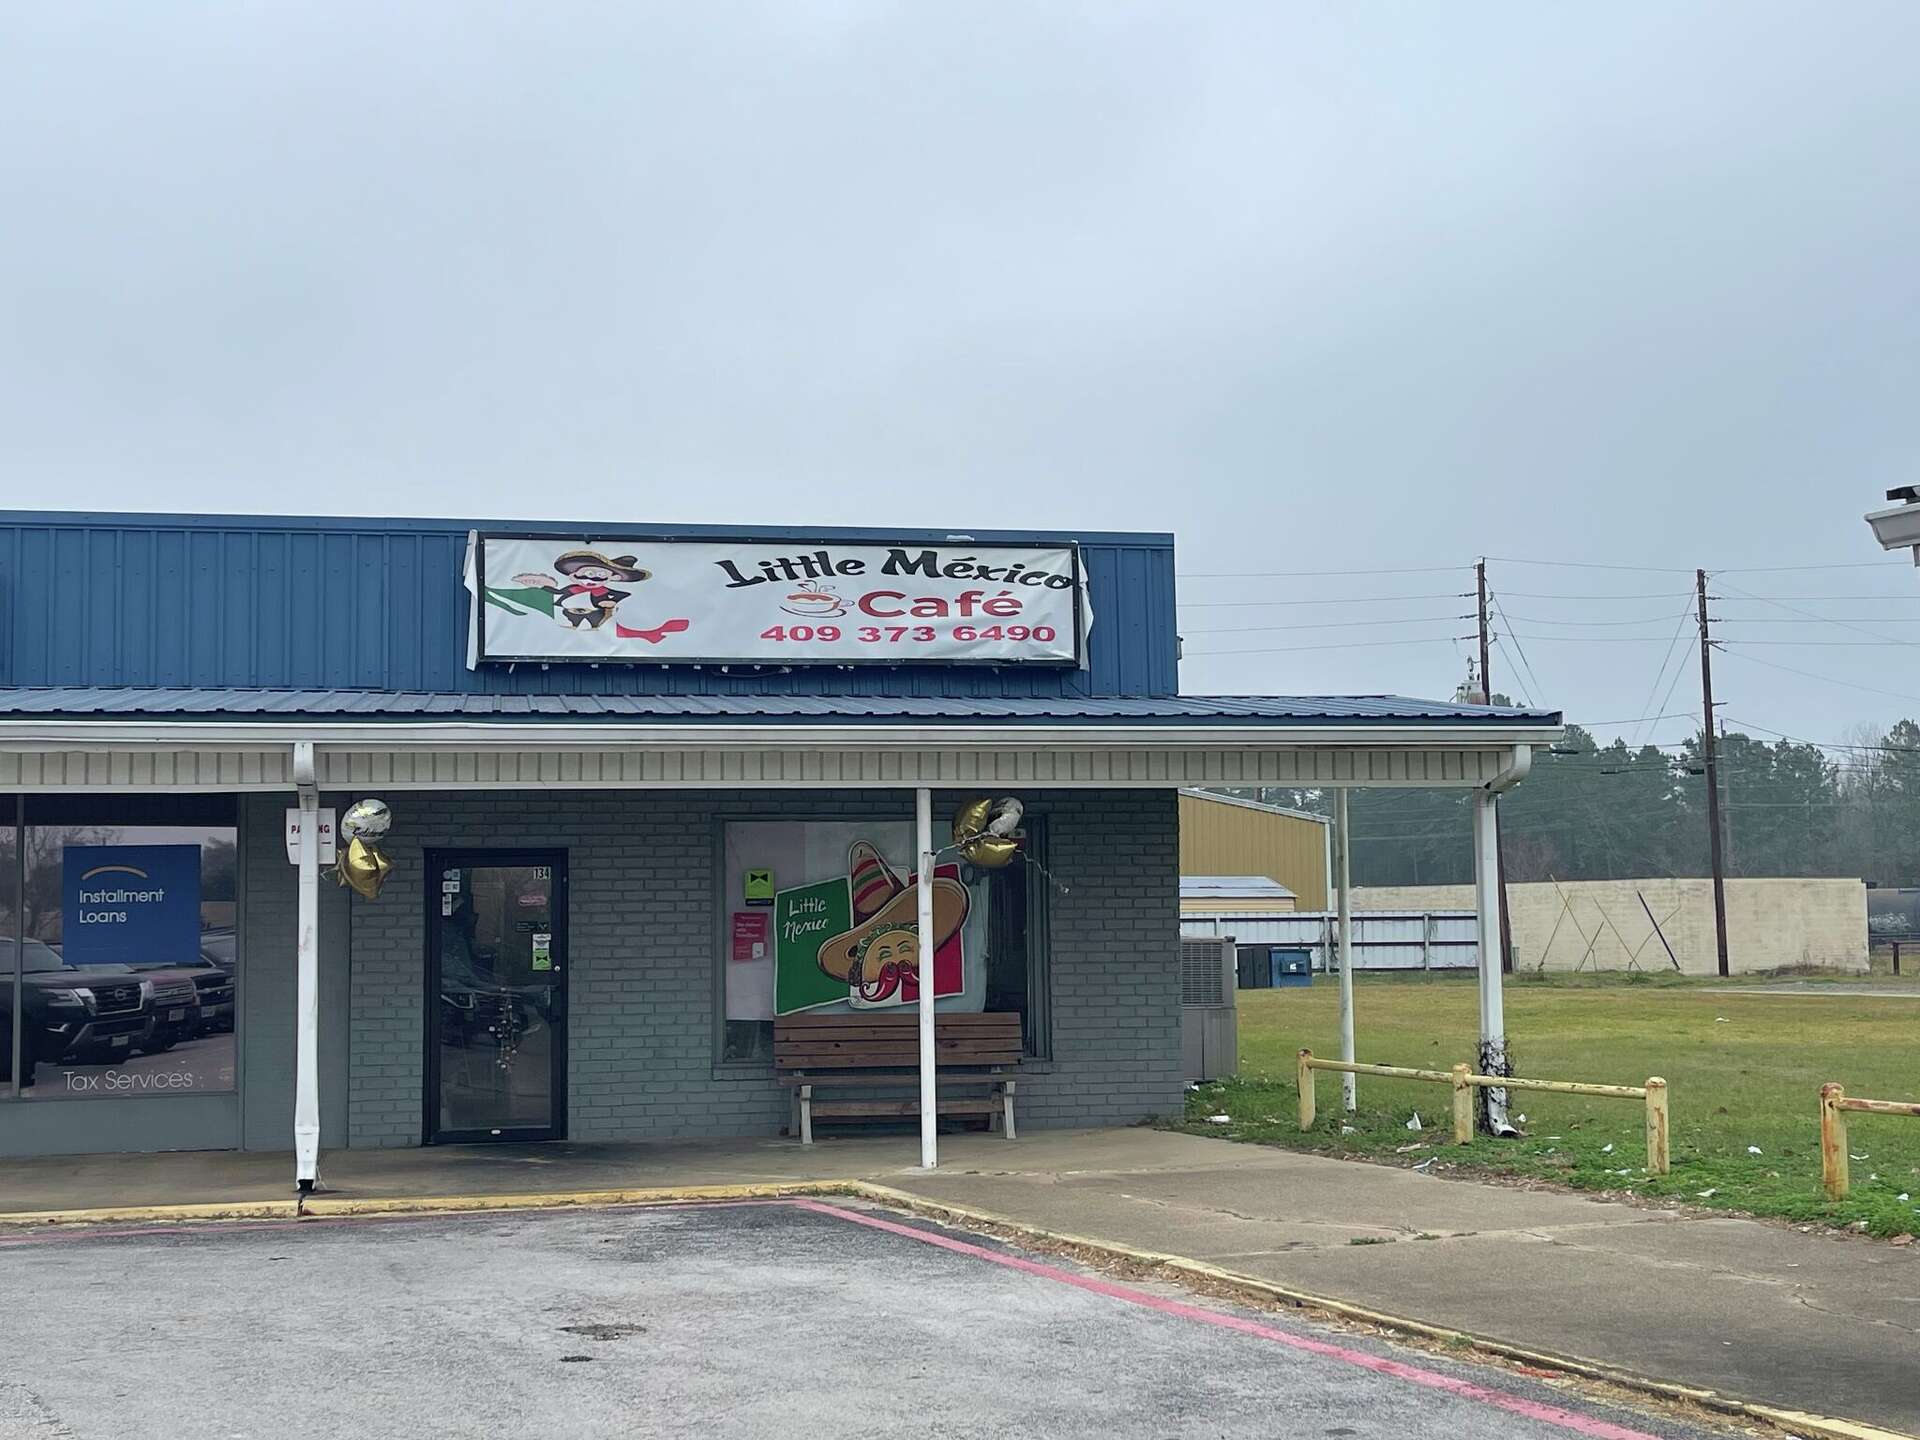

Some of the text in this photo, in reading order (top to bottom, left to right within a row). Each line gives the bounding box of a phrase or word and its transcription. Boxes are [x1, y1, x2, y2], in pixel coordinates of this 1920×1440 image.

[714, 549, 1078, 590] Little México
[858, 590, 1023, 618] Café
[760, 625, 1056, 642] 409 373 6490
[80, 888, 165, 904] Installment
[788, 896, 827, 917] Little
[80, 909, 127, 923] Loans
[63, 1070, 193, 1091] Tax Services
